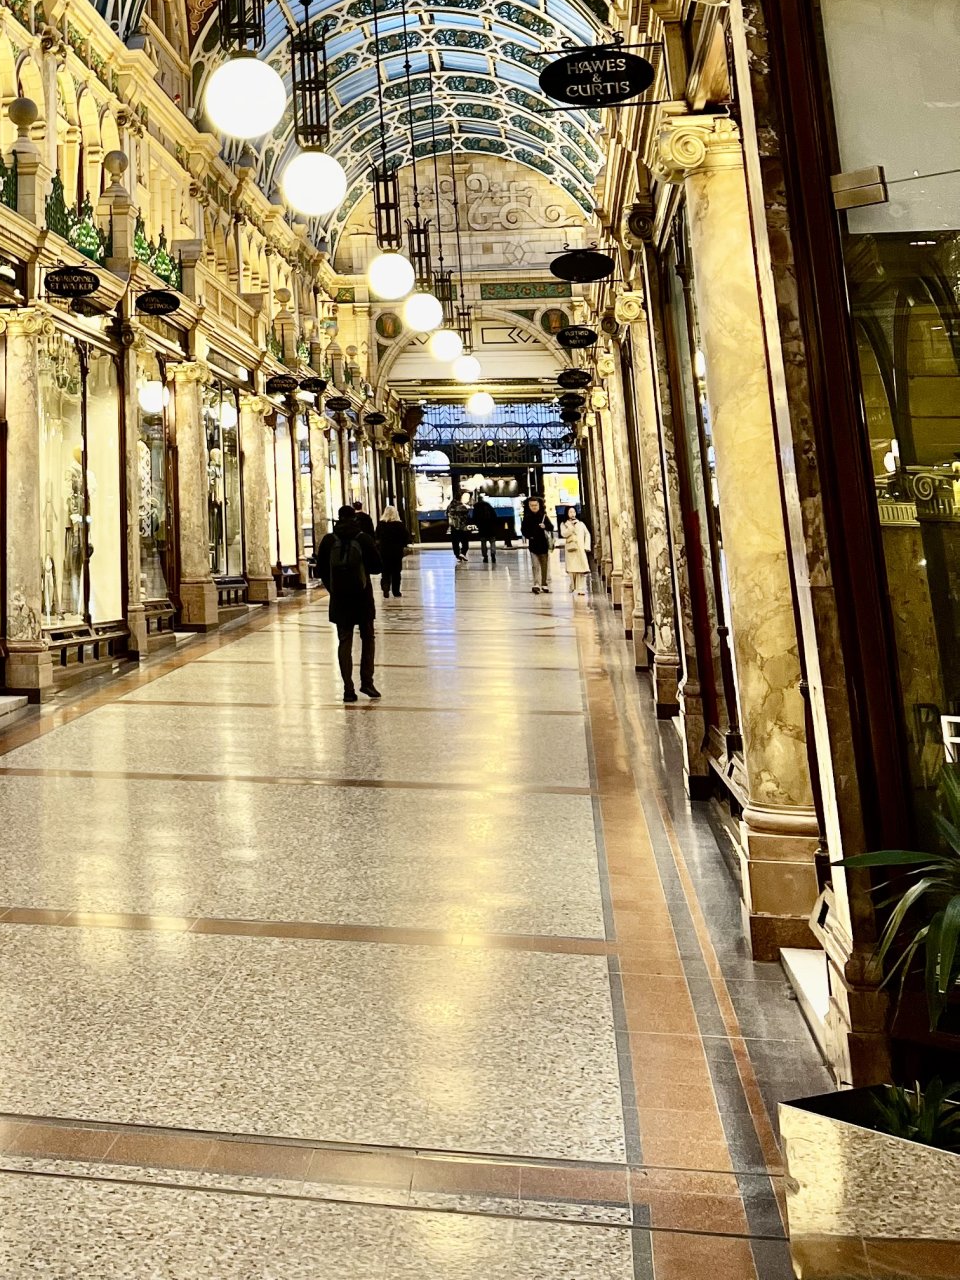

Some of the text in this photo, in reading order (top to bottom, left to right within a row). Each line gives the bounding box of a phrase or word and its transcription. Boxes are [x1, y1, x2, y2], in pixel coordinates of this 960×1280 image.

[566, 58, 627, 75] HAWES
[592, 73, 602, 83] &
[565, 81, 631, 97] CURTIS
